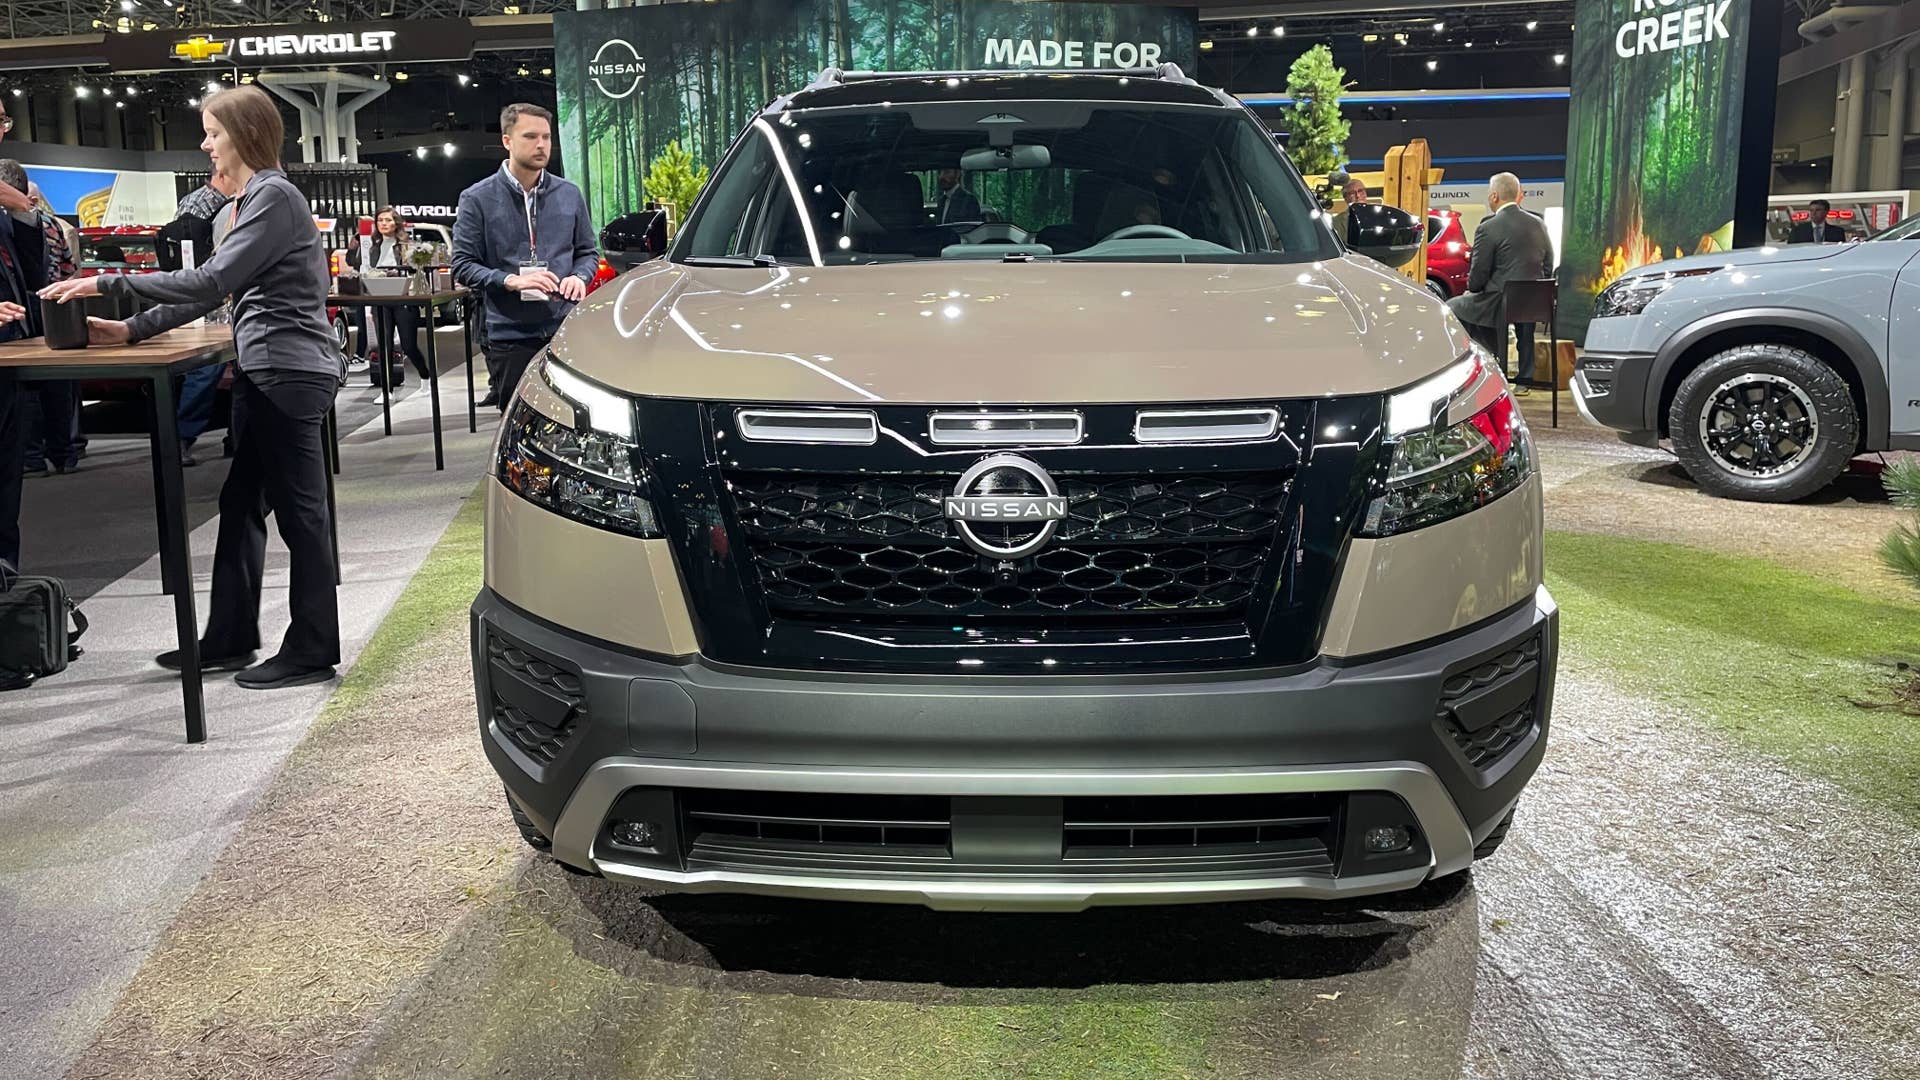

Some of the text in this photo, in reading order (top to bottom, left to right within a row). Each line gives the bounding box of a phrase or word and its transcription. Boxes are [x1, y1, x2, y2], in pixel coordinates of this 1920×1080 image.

[1615, 0, 1733, 58] CREEK
[239, 31, 396, 56] CHEVROLET
[984, 38, 1162, 68] MADE FOR
[588, 63, 646, 75] NISSAN
[948, 501, 1064, 517] NISSAN
